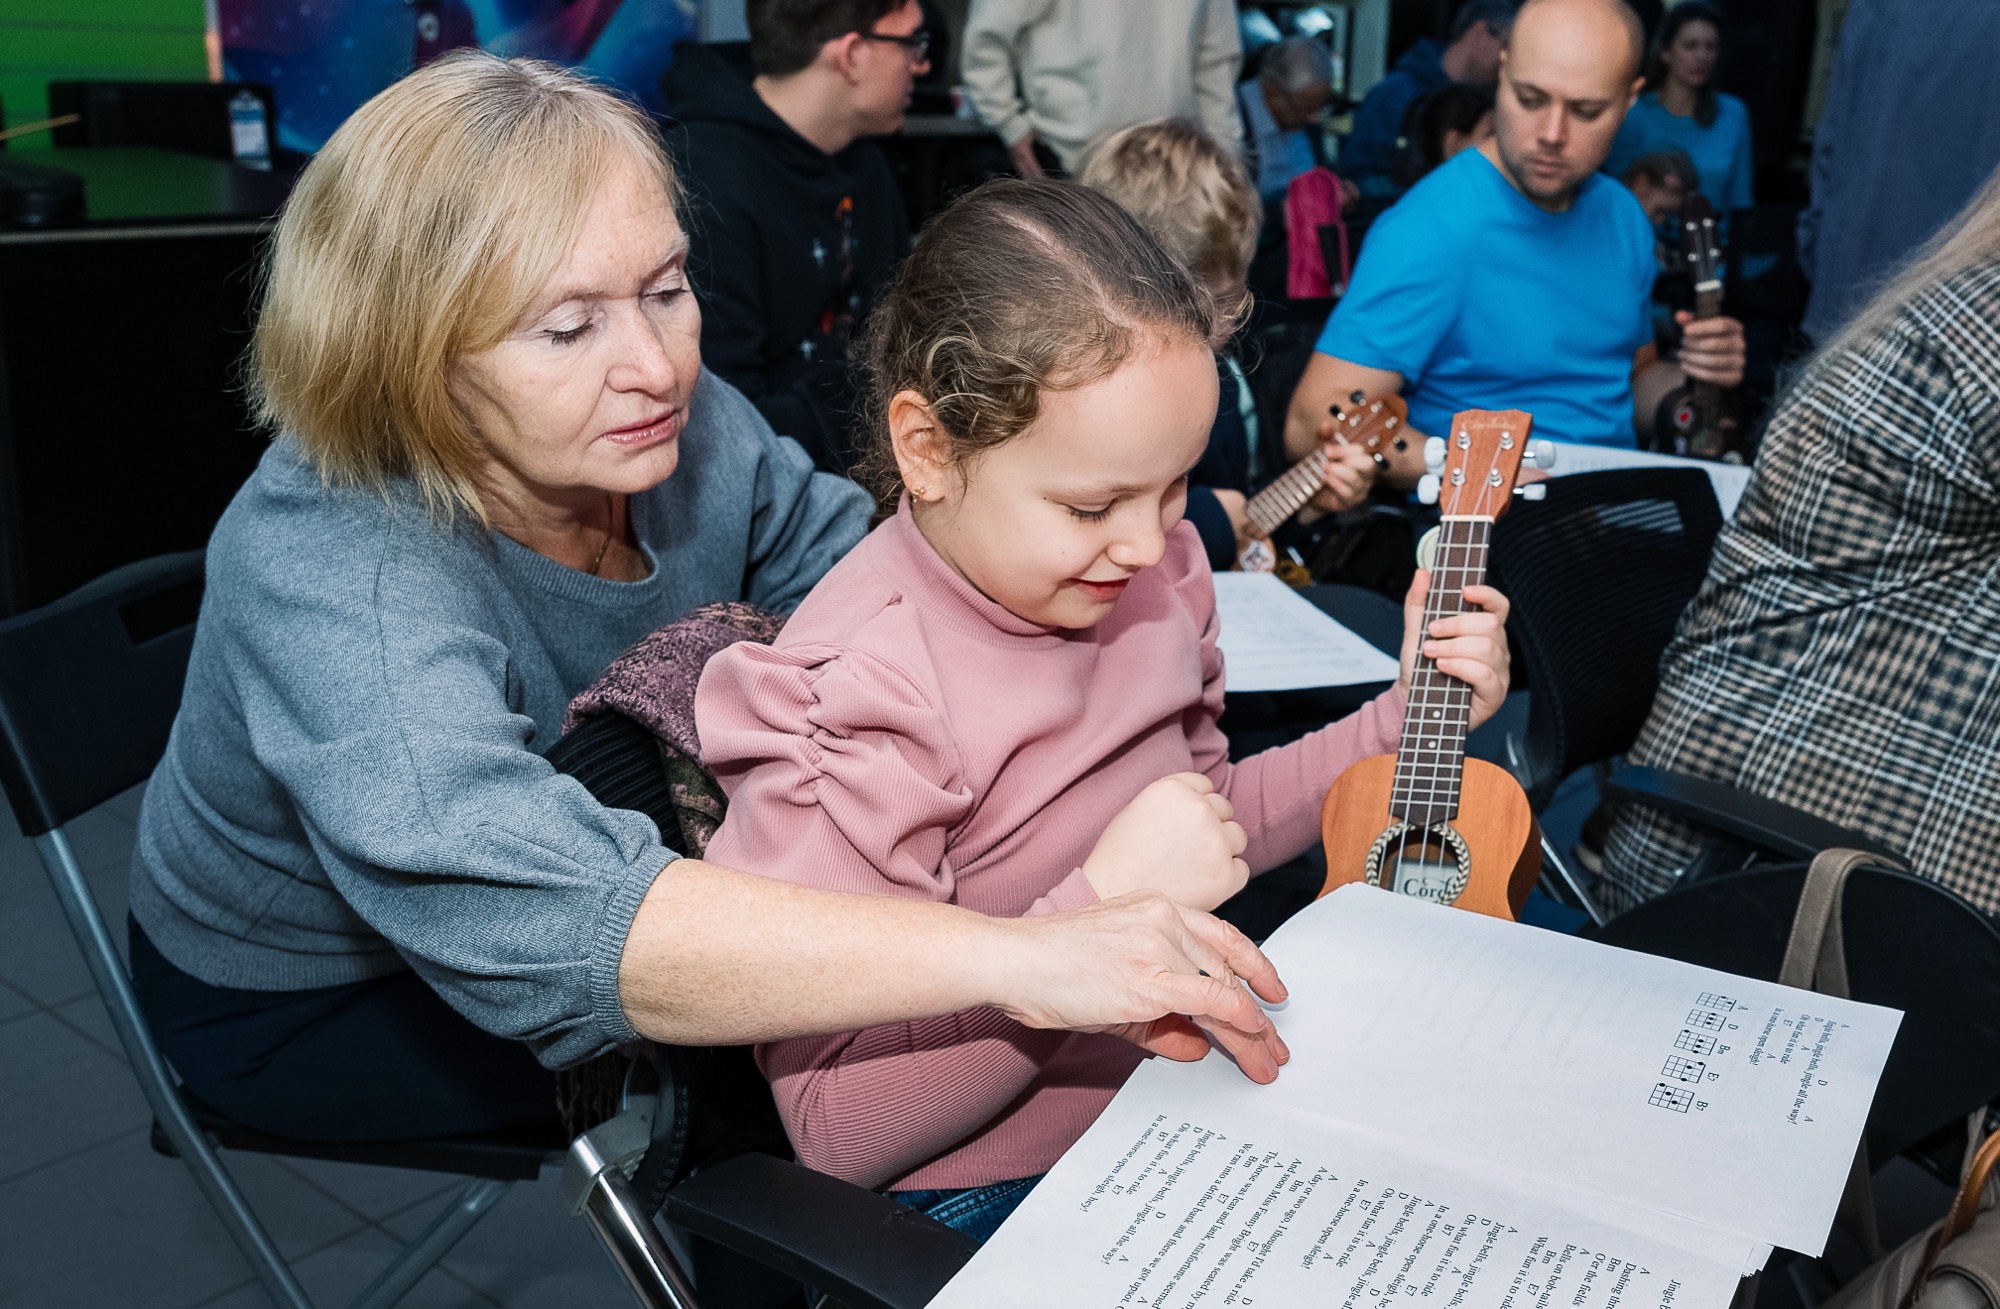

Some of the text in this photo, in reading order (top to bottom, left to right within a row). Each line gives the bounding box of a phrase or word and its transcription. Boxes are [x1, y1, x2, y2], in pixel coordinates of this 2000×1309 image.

[1717, 1044, 1731, 1055] Bm
[1707, 1072, 1720, 1081] E7
[1695, 1100, 1708, 1112] B7
[1155, 1114, 1168, 1122] In
[1177, 1122, 1191, 1133] Oh
[1125, 1127, 1155, 1158] one-horse
[1164, 1133, 1181, 1150] what
[1238, 1143, 1254, 1154] We
[1154, 1149, 1170, 1161] fun
[1228, 1153, 1242, 1166] ran
[1242, 1155, 1259, 1168] Bm
[1262, 1151, 1279, 1164] The
[1111, 1131, 1169, 1196] B7 E7
[1111, 1157, 1129, 1174] open
[1137, 1173, 1148, 1181] to
[1218, 1165, 1235, 1179] into
[1248, 1163, 1269, 1182] horse
[1091, 1174, 1115, 1195] sleigh,
[1125, 1180, 1141, 1195] ride
[1307, 1173, 1323, 1188] day
[1356, 1179, 1369, 1187] In
[1100, 1129, 1216, 1265] Jingle bells, jingle bells, jingle all the way!
[1196, 1184, 1219, 1208] drifted
[1237, 1182, 1253, 1196] was
[1303, 1187, 1313, 1196] or
[1381, 1187, 1396, 1199] Oh
[1398, 1192, 1410, 1200] D
[1079, 1196, 1099, 1213] hey!
[1216, 1193, 1230, 1205] E7
[1226, 1195, 1244, 1211] lean
[1293, 1195, 1308, 1209] two
[1358, 1199, 1372, 1211] E7
[1155, 1211, 1167, 1219] D
[1183, 1207, 1203, 1224] bank
[1246, 1179, 1305, 1253] Bm E7
[1280, 1209, 1297, 1224] ago,
[1329, 1193, 1357, 1227] one-horse
[1369, 1200, 1386, 1218] what
[1437, 1204, 1450, 1214] In
[1215, 1210, 1230, 1226] and
[1360, 1217, 1376, 1230] fun
[1172, 1224, 1187, 1239] and
[1190, 1157, 1303, 1302] And soon Miss Fanny Bright was seated by
[1200, 1224, 1222, 1241] lank,
[1317, 1226, 1334, 1245] open
[1412, 1219, 1439, 1254] one-horse
[1158, 1238, 1177, 1257] there
[1258, 1229, 1284, 1257] thought
[1346, 1244, 1357, 1253] to
[1348, 1195, 1423, 1301] Jingle bells, jingle bells, jingle
[1351, 1236, 1364, 1245] is
[1451, 1218, 1492, 1274] D A
[1149, 1257, 1162, 1268] we
[1173, 1242, 1206, 1281] misfortune
[1251, 1256, 1265, 1268] I'd
[1300, 1244, 1322, 1270] sleigh!
[1335, 1252, 1351, 1268] ride
[1400, 1254, 1417, 1273] open
[1404, 1223, 1455, 1297] B7 E7
[1420, 1214, 1477, 1297] Oh what fun it is to ride
[1446, 1221, 1506, 1307] Jingle bells, jingle bells,
[1606, 1257, 1622, 1272] Bm
[1138, 1267, 1152, 1282] got
[1239, 1267, 1256, 1284] take
[1499, 1236, 1549, 1309] What fun it is to ride
[1526, 1249, 1557, 1296] Bm E7
[1535, 1243, 1577, 1309] Bells on bob-tails
[1572, 1252, 1606, 1307] O'er the fields
[1610, 1262, 1637, 1295] Dashing
[1120, 1281, 1142, 1303] upsot.
[1383, 1272, 1406, 1296] sleigh,
[1662, 1278, 1682, 1304] Jingle
[1223, 1289, 1240, 1305] ride
[1369, 1288, 1381, 1297] D
[1241, 1297, 1253, 1306] D
